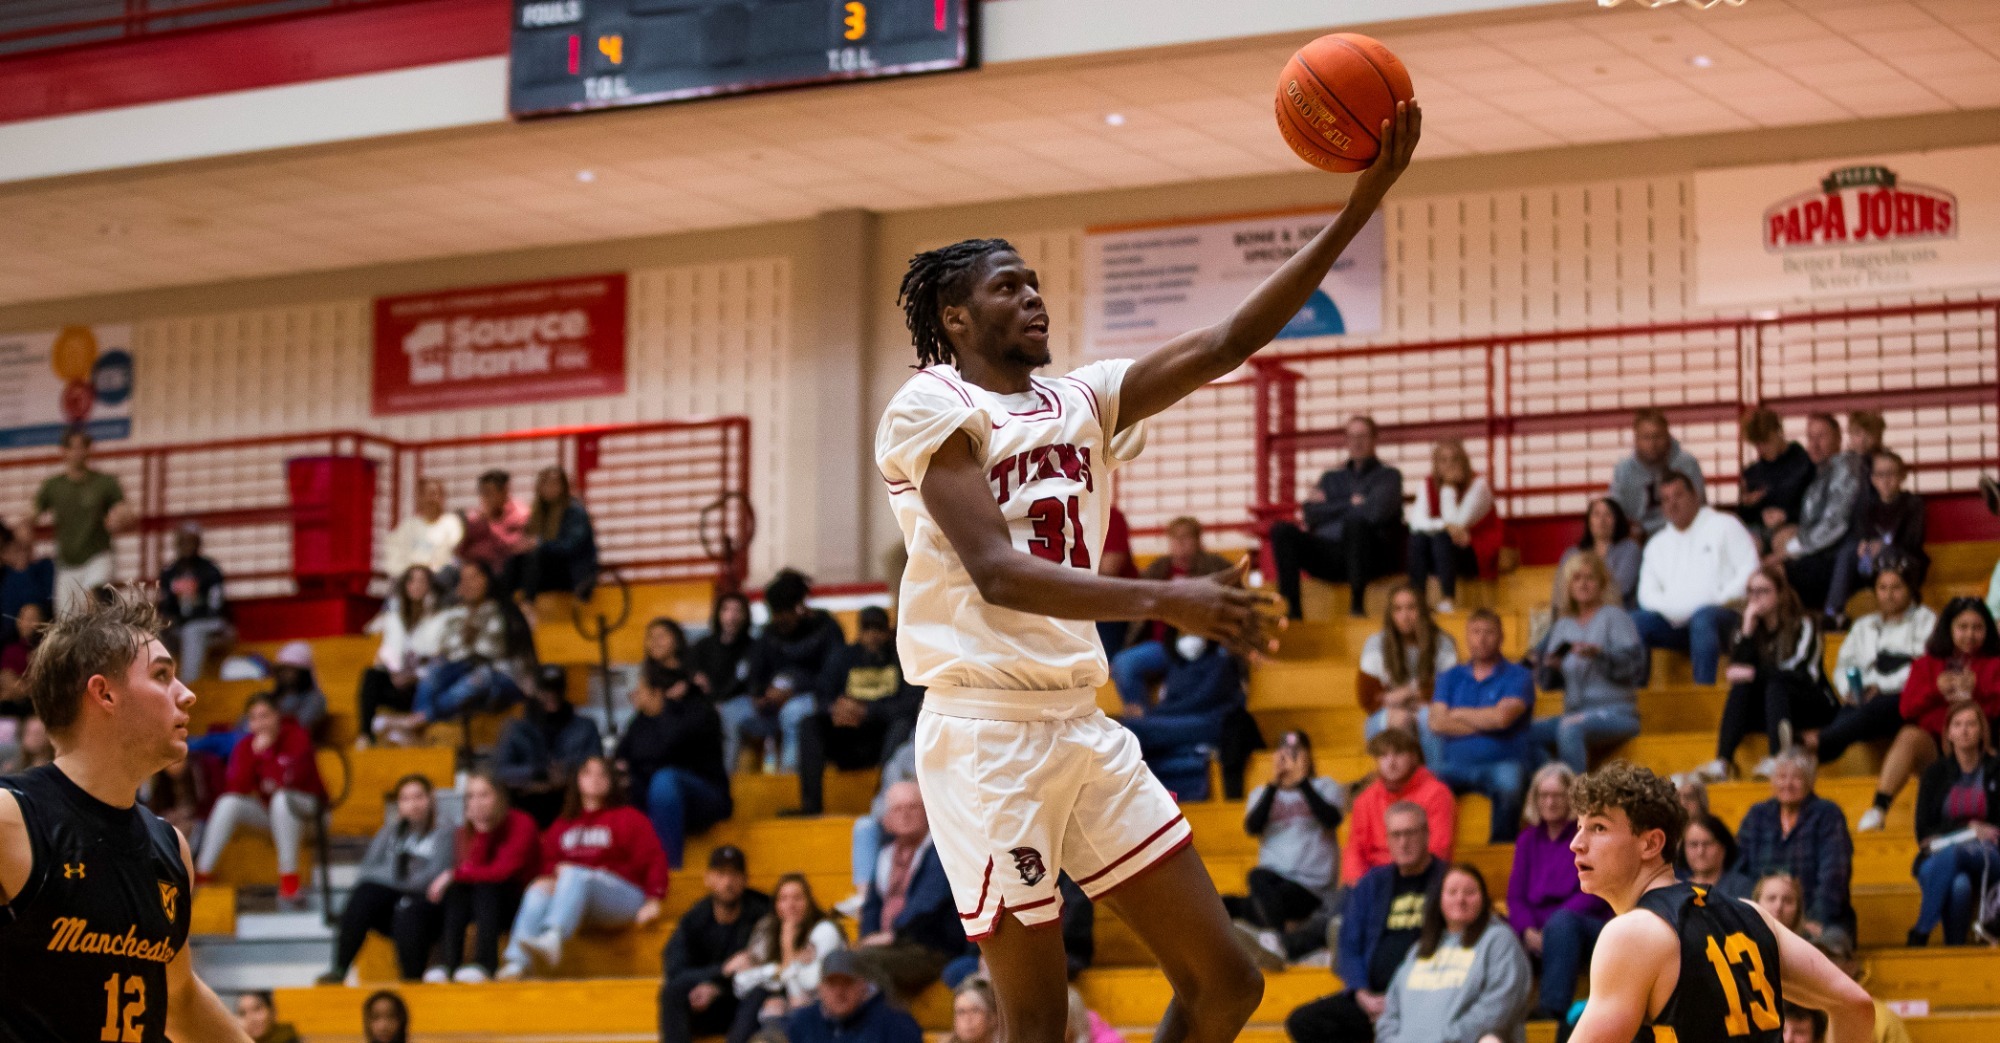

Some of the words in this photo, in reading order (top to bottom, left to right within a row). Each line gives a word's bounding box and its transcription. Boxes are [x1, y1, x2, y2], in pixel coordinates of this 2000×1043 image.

[522, 0, 580, 27] FOULS
[844, 1, 867, 40] 3
[598, 35, 623, 64] 4
[1769, 192, 1847, 246] PAPA
[451, 311, 588, 350] Source
[451, 344, 549, 380] Bank
[1027, 495, 1091, 569] 31
[1705, 931, 1781, 1037] 13
[100, 972, 147, 1043] 12
